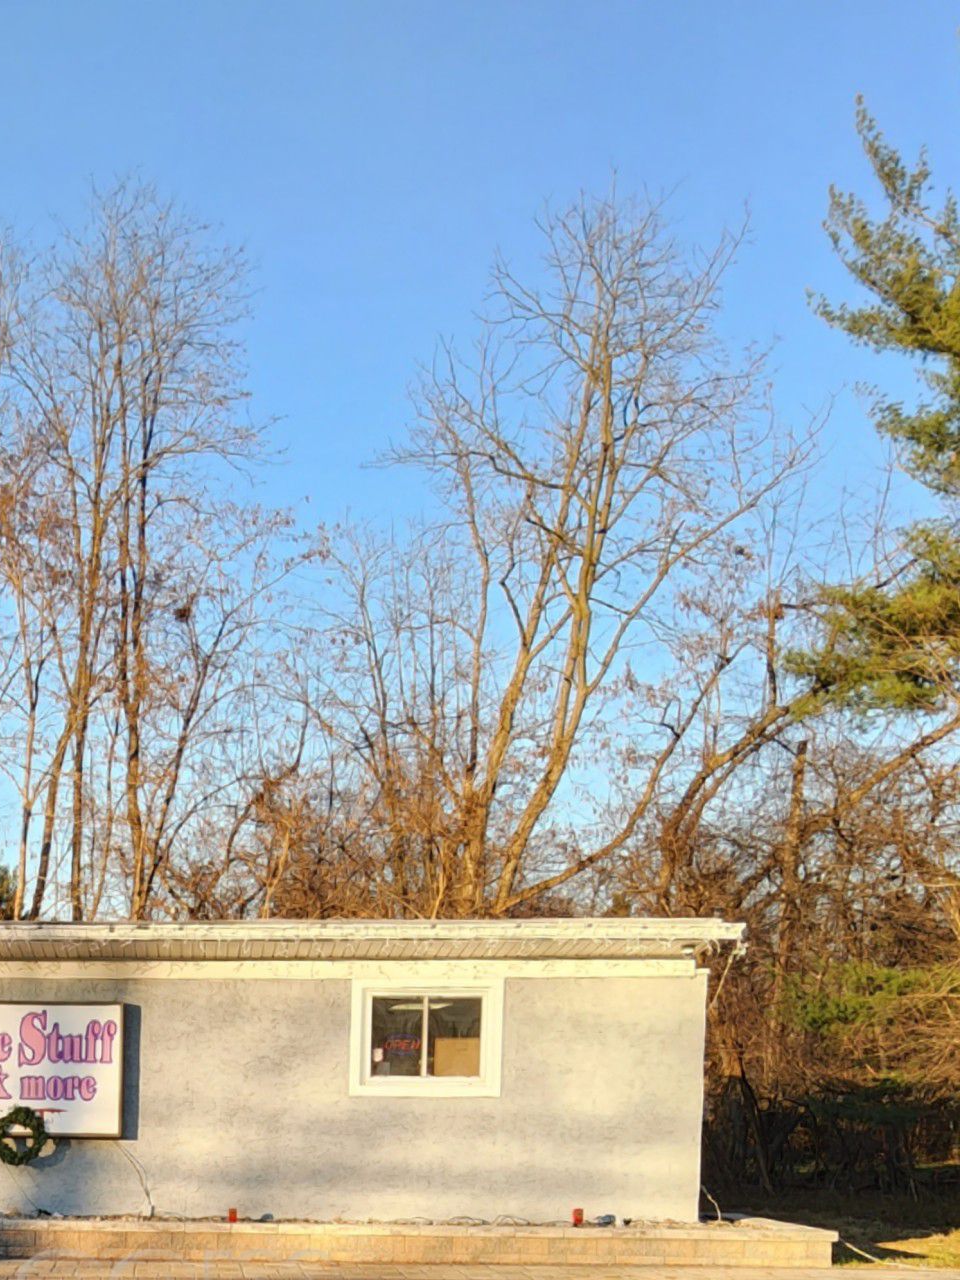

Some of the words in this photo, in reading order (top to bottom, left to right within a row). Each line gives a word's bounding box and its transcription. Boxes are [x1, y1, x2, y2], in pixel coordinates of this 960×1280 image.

[18, 1010, 117, 1067] Stuff
[384, 1038, 421, 1051] OPEN
[19, 1075, 97, 1101] more
